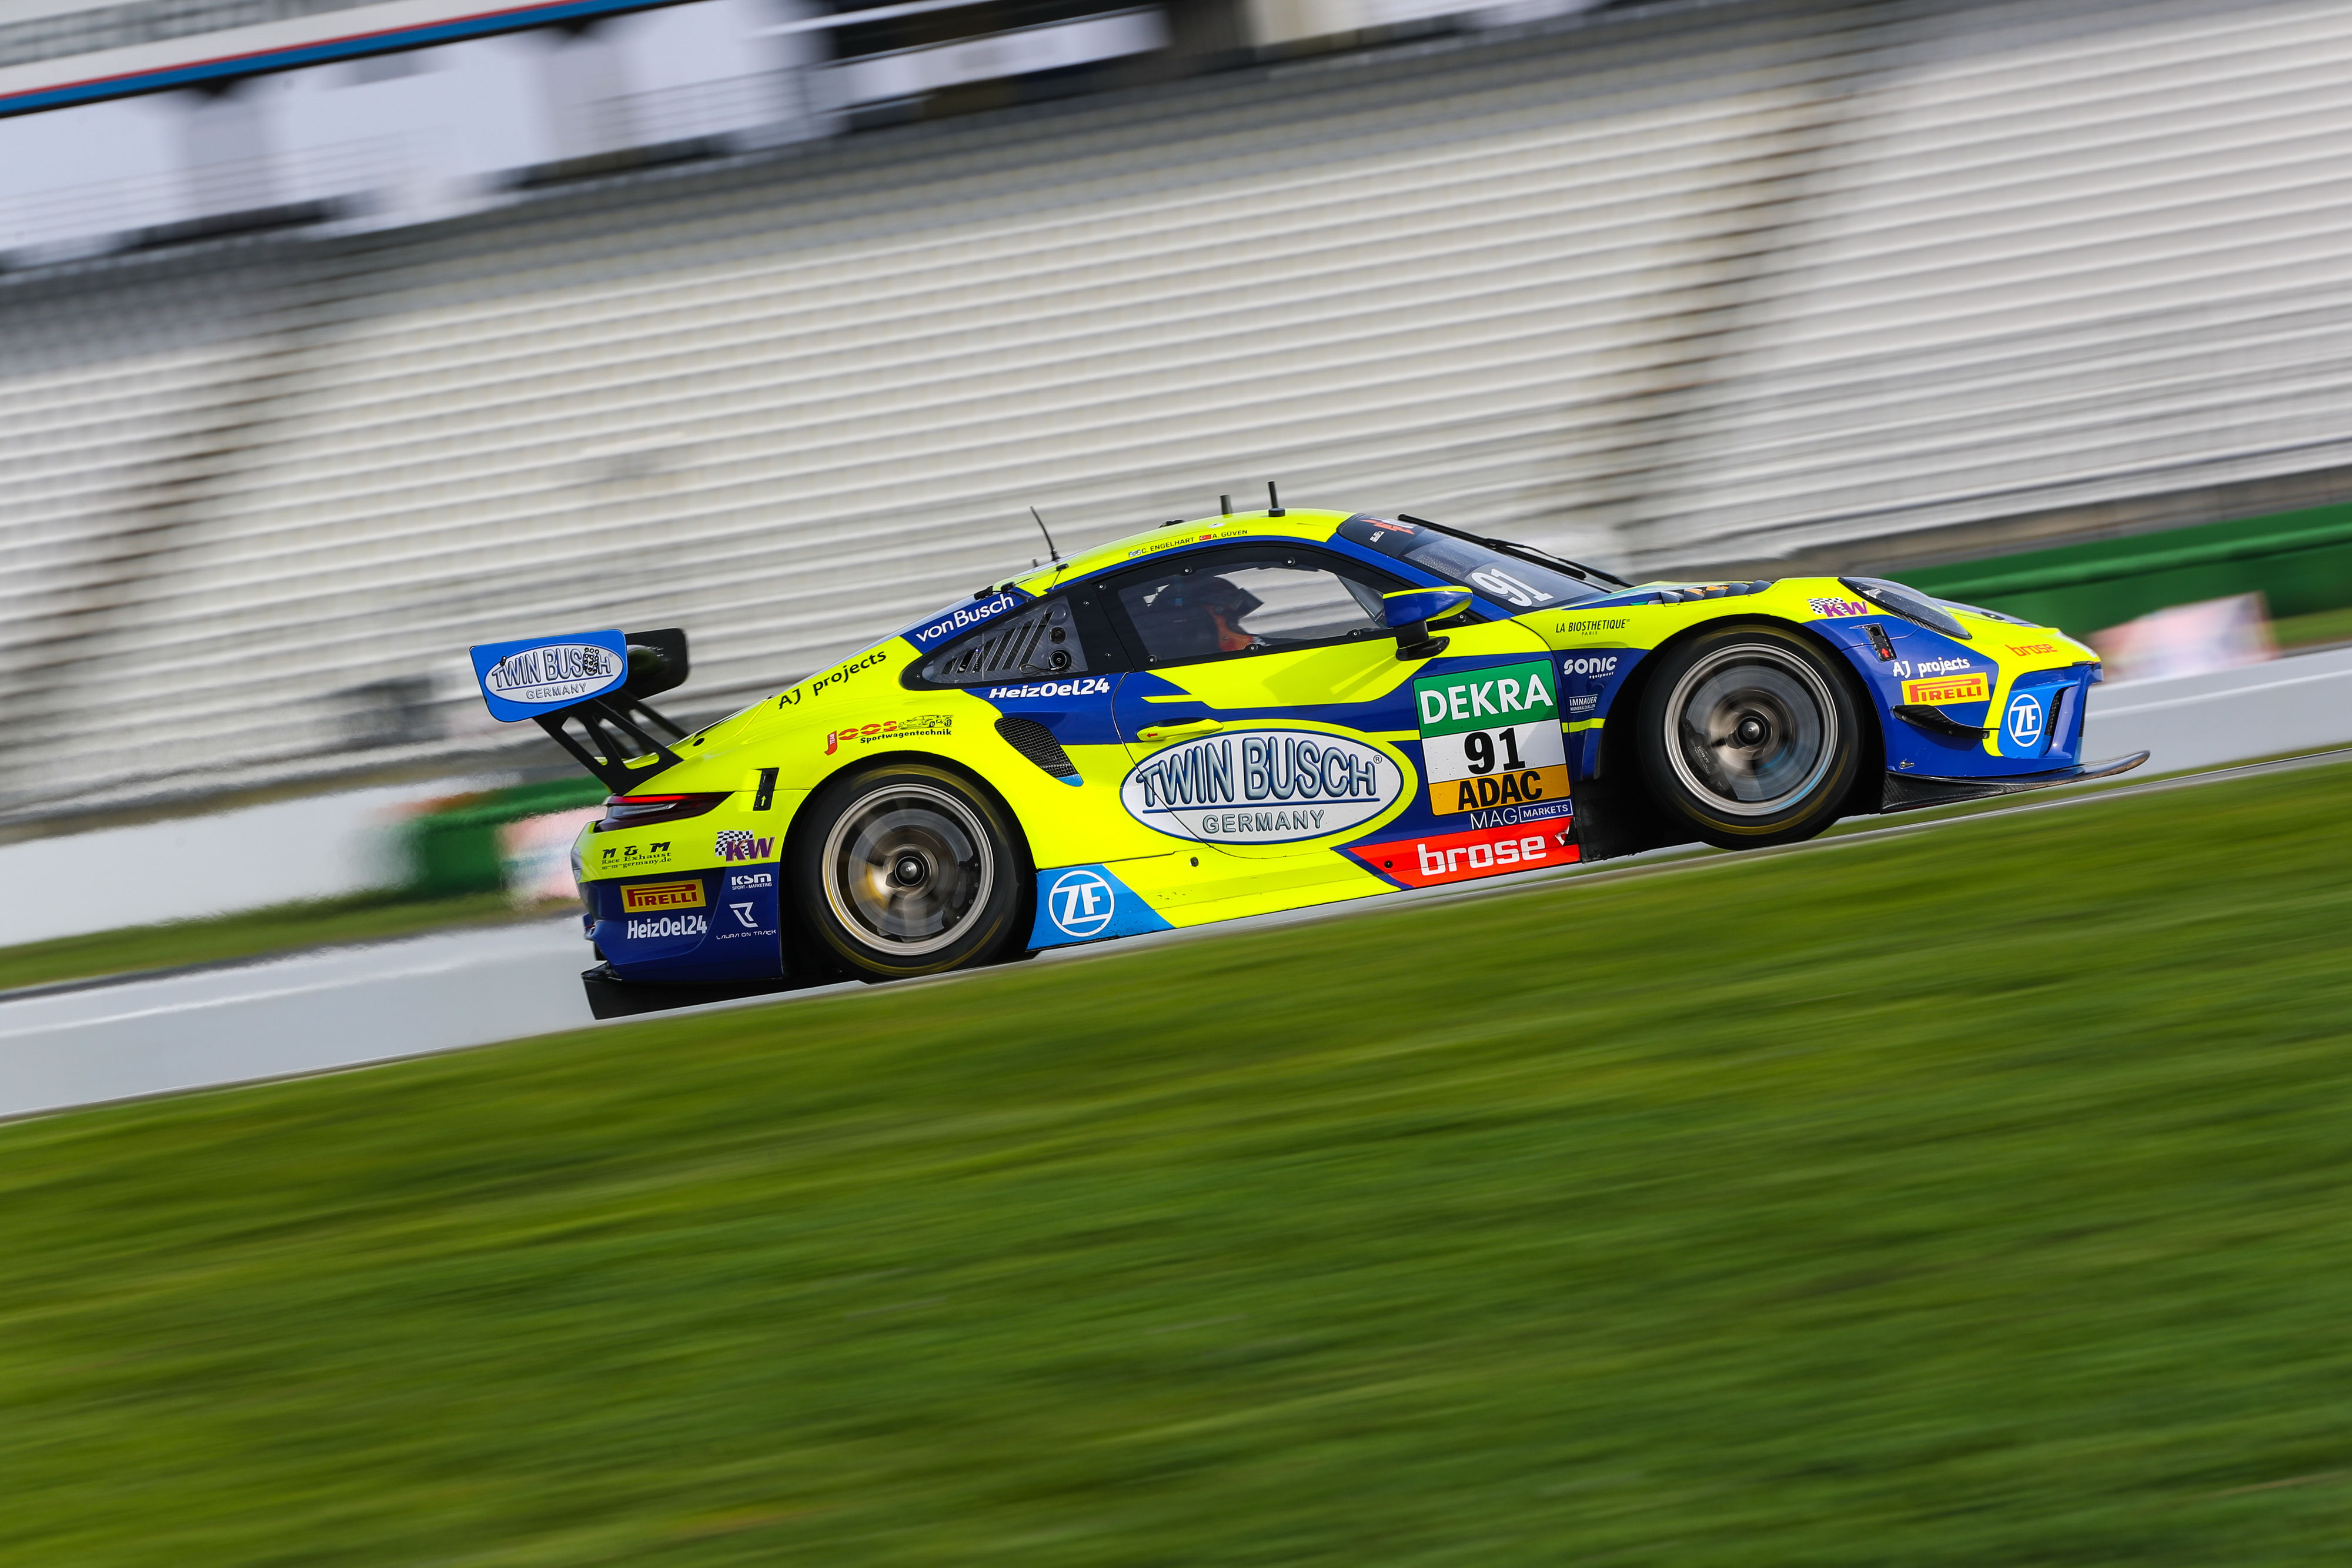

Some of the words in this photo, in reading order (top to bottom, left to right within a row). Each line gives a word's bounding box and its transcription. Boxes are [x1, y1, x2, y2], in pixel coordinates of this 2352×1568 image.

[1150, 536, 1195, 551] ENGELHART
[1472, 569, 1553, 607] 91
[1822, 601, 1869, 618] KW
[1556, 623, 1565, 633] LA
[2007, 643, 2058, 657] brose
[492, 651, 542, 688] TWIN
[1892, 660, 1911, 679] AJ
[1917, 656, 1971, 678] projects
[526, 682, 587, 700] GERMANY
[779, 688, 801, 710] AJ
[812, 650, 887, 696] projects
[988, 678, 1110, 700] HeizOel24
[1909, 679, 1982, 703] PIRELLI
[1419, 674, 1553, 725] DEKRA
[1569, 696, 1598, 706] IMNAUER
[2012, 706, 2036, 737] ZF
[860, 728, 952, 744] Sportwagentechnik
[1464, 728, 1526, 775] 91
[1135, 738, 1235, 807] TWIN
[1458, 770, 1543, 811] ADAC
[1202, 809, 1325, 834] GERMANY
[1470, 807, 1518, 830] MAG
[1523, 804, 1569, 818] MARKETS
[602, 848, 617, 859] M
[649, 841, 671, 852] M
[624, 852, 671, 861] Exhaust
[725, 837, 776, 862] KW
[1417, 835, 1547, 876] brose
[602, 857, 671, 870] m-m-germany.de
[626, 883, 697, 907] PIRELLI
[627, 915, 707, 940] HeizOel24
